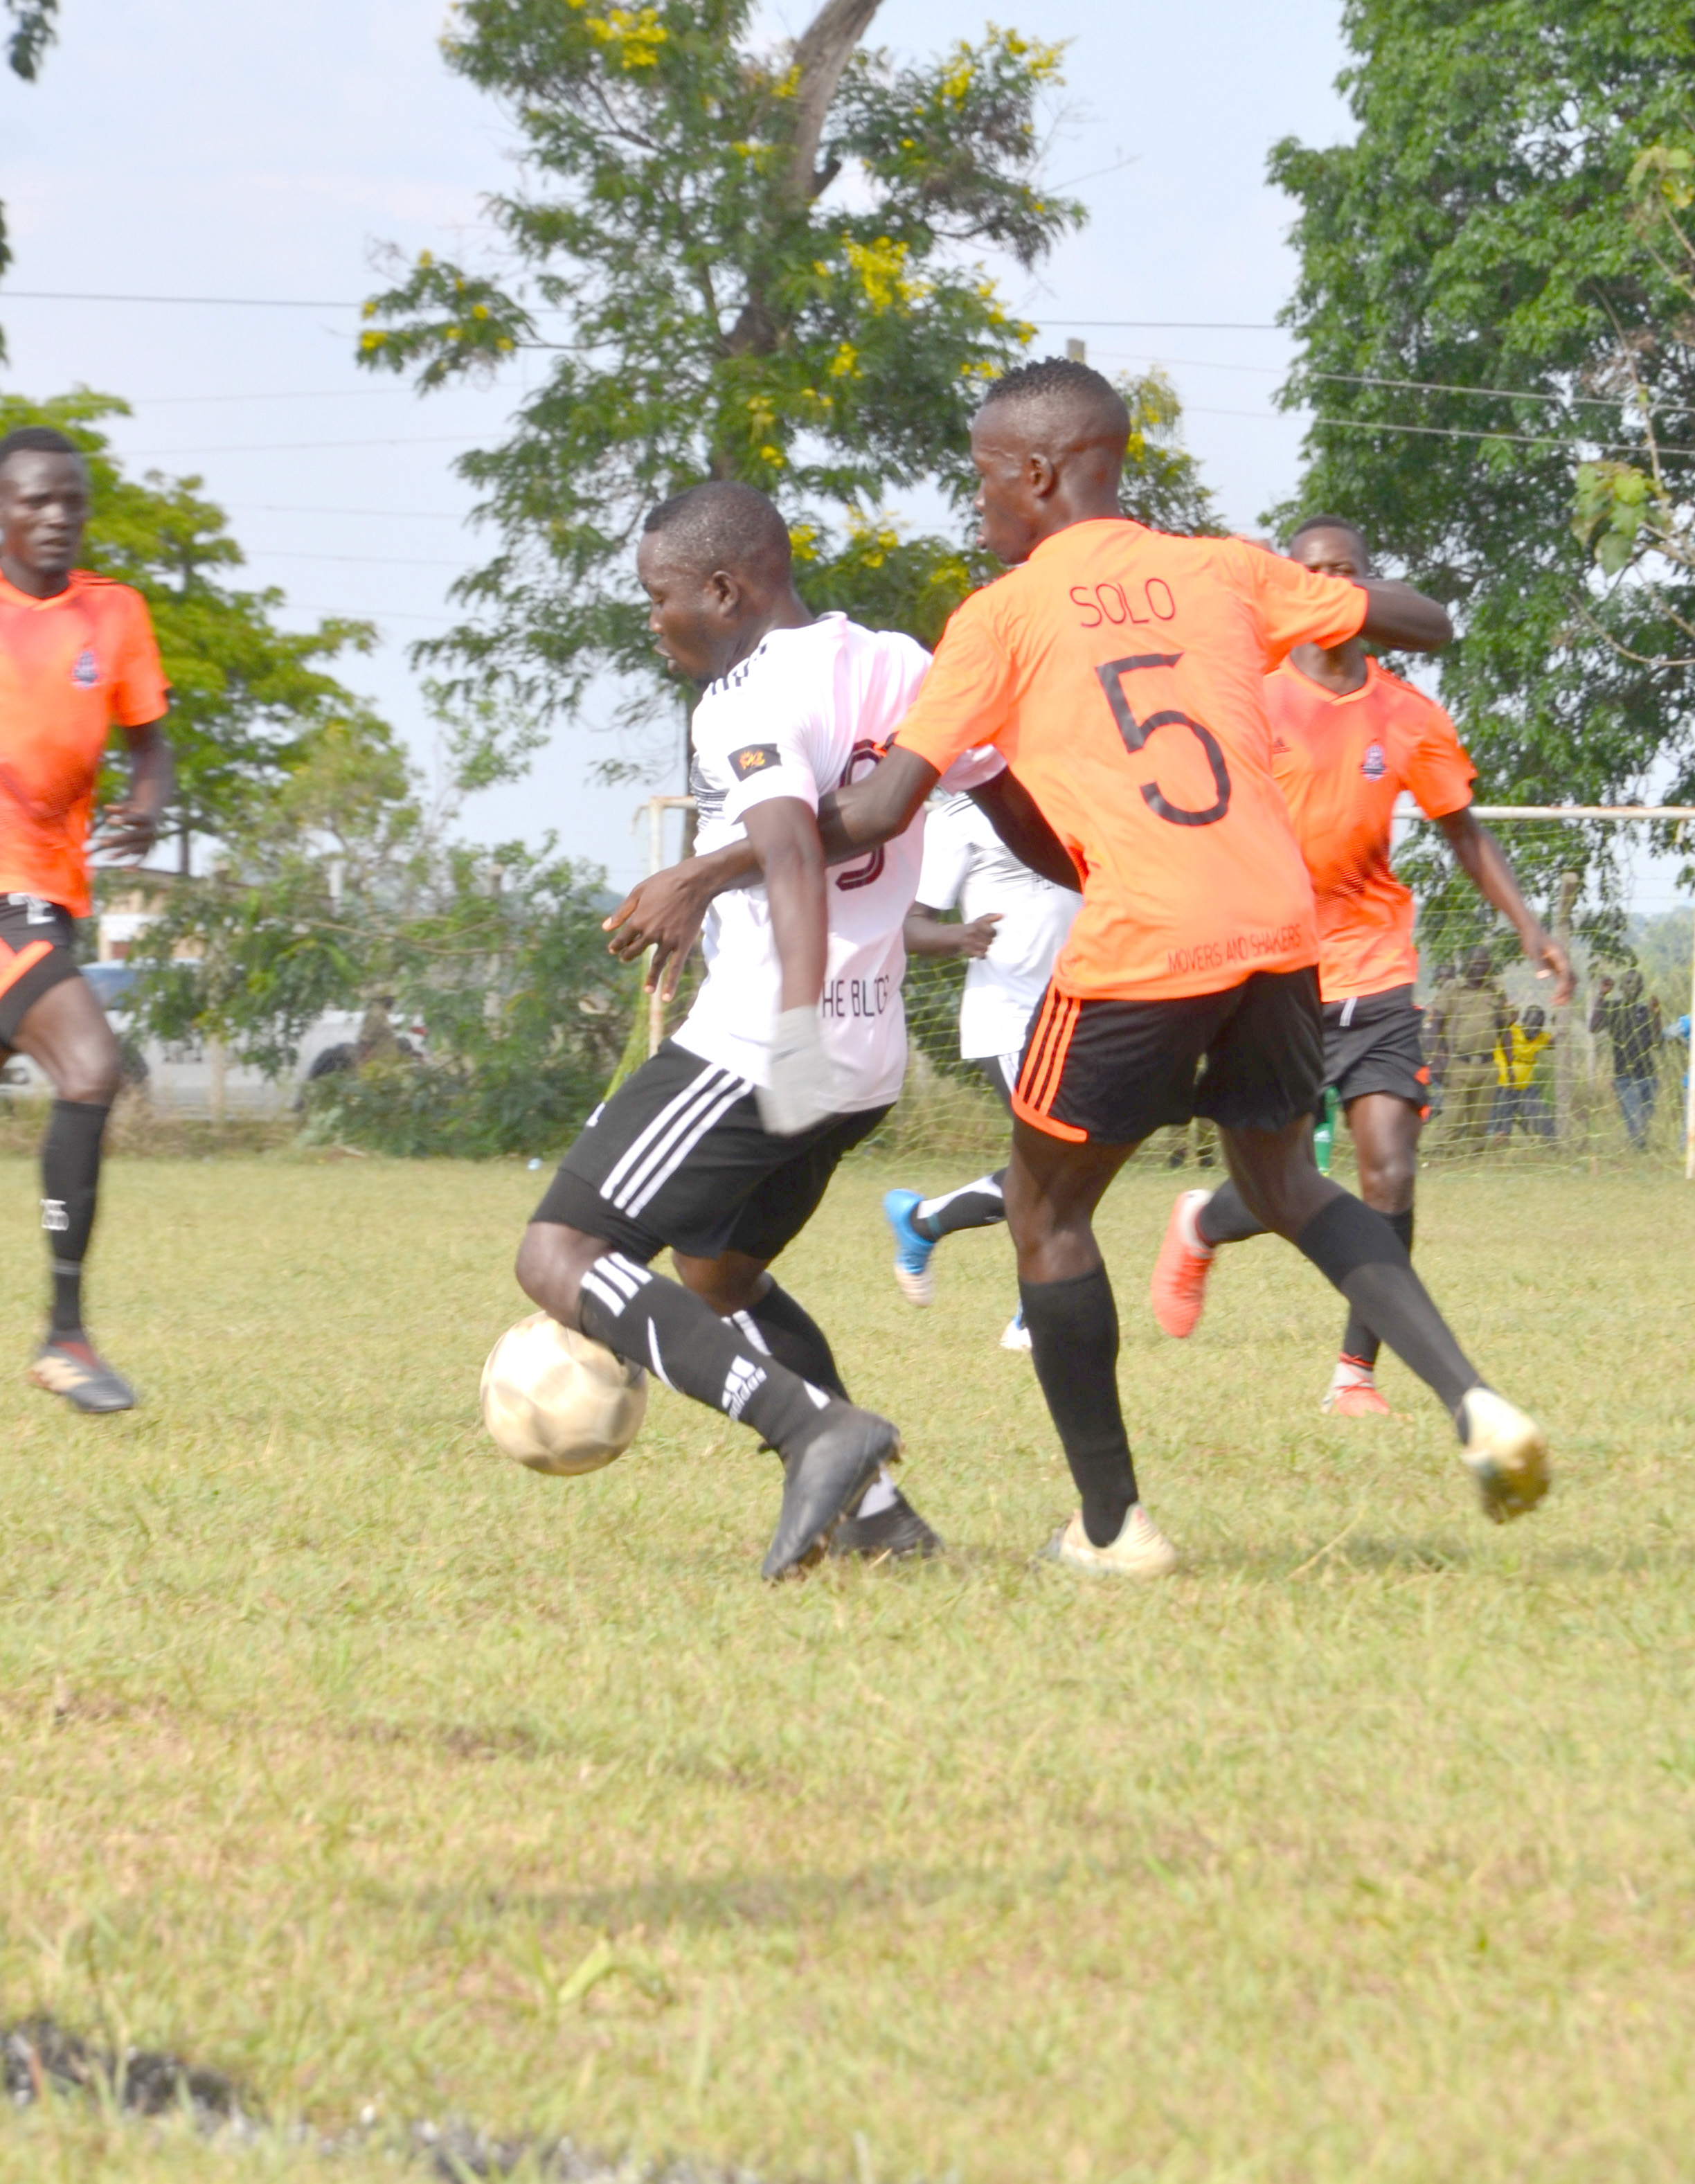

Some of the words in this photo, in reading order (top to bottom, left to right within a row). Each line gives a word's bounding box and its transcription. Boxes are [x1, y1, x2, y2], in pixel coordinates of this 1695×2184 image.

[1070, 578, 1176, 628] SOLO
[1094, 652, 1232, 827] 5
[1167, 941, 1223, 974] MOVERS
